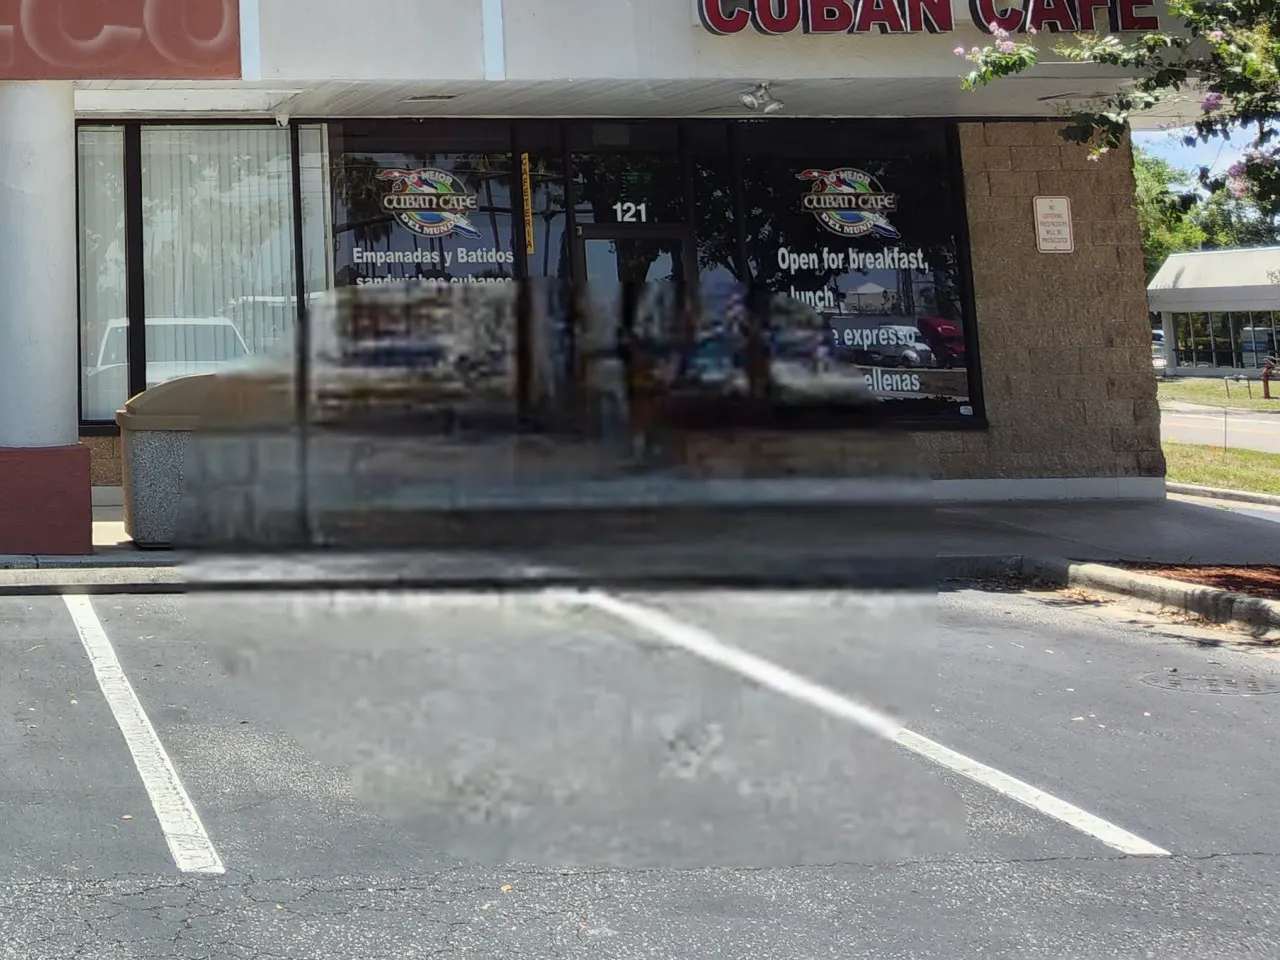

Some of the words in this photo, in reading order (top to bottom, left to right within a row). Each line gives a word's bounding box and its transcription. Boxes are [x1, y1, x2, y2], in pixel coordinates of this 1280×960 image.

[420, 171, 453, 186] MEJOR
[839, 170, 871, 186] MEJOR
[383, 195, 437, 209] CUBAN
[804, 195, 857, 209] CUBAN
[613, 202, 647, 222] 121
[353, 247, 440, 266] Empanadas
[444, 251, 453, 266] y
[457, 247, 514, 263] Batidos
[777, 247, 818, 275] Open
[822, 247, 844, 270] for
[848, 247, 929, 274] breakfast,
[843, 328, 918, 350] expresso
[864, 368, 920, 391] ellenas
